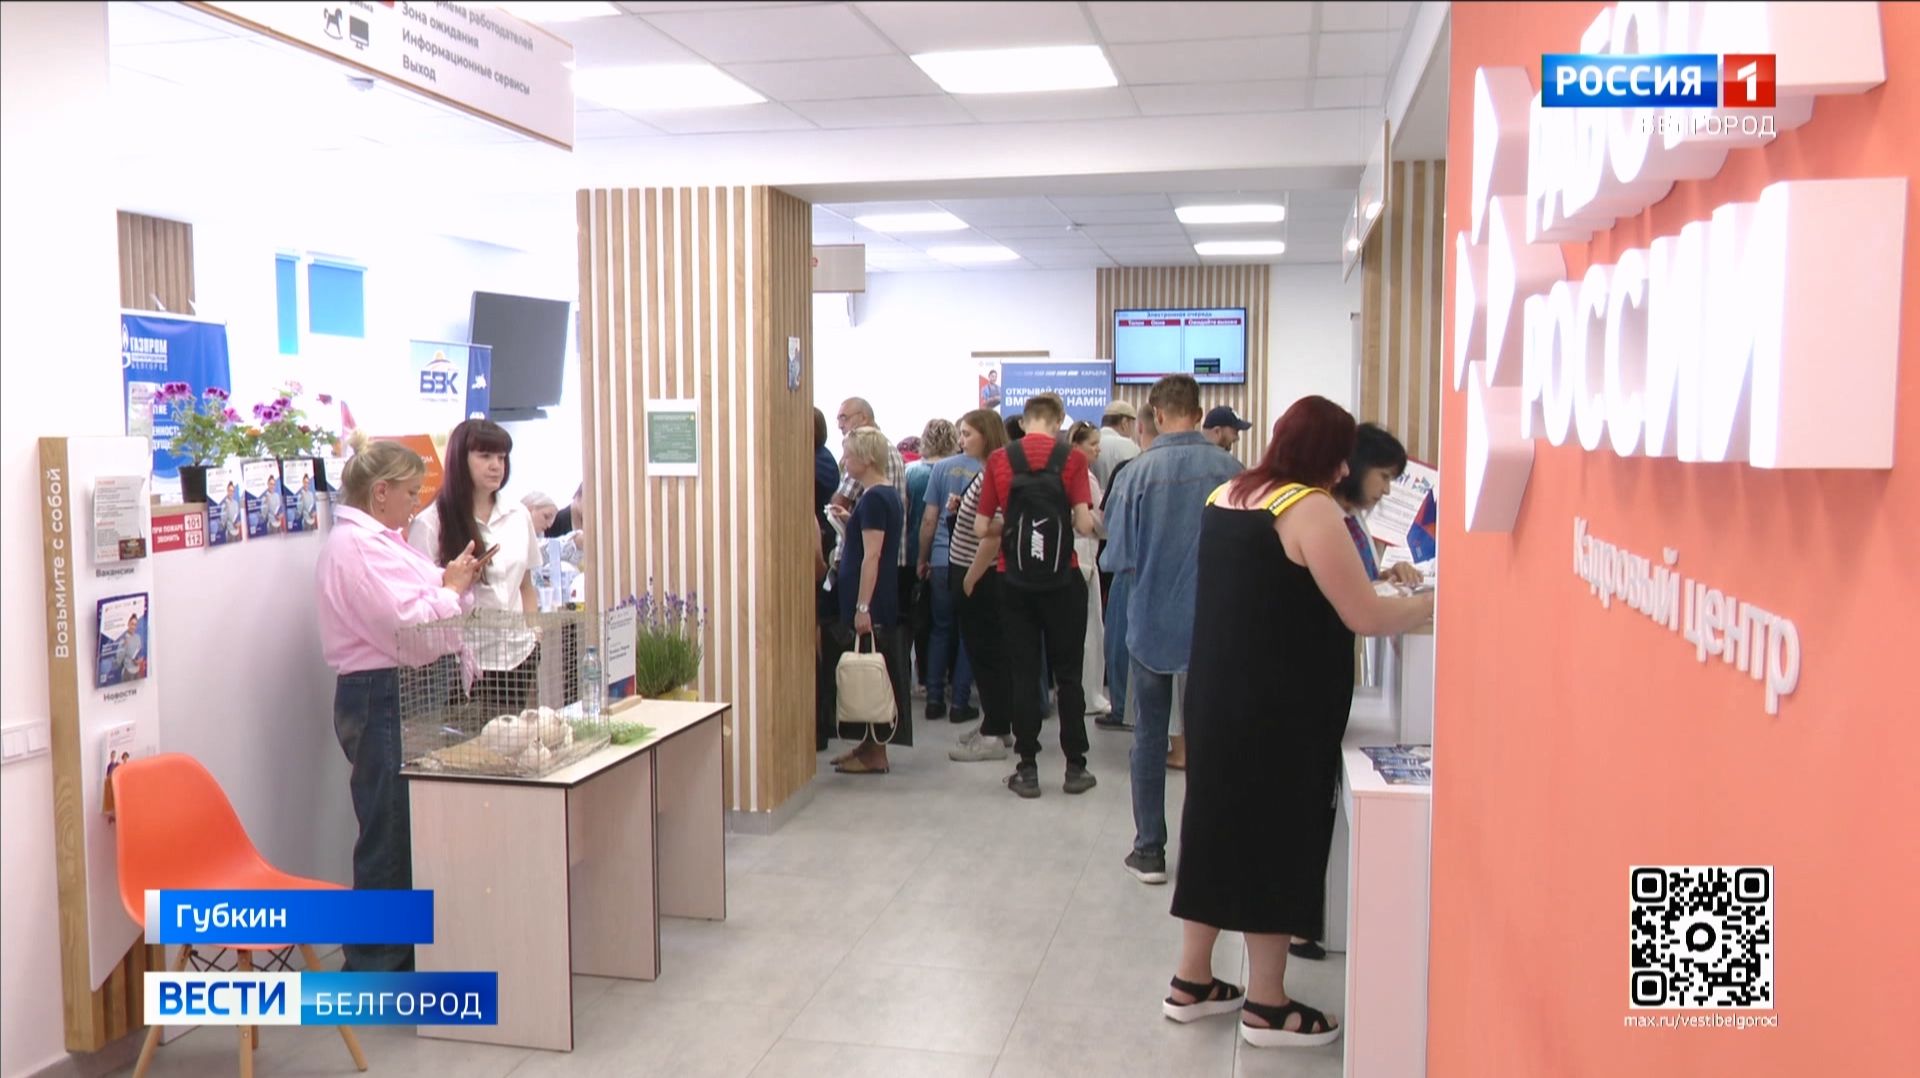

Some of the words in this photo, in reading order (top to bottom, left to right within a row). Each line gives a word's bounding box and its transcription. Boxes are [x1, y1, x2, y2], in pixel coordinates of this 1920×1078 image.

[402, 2, 428, 26] Зона
[430, 18, 480, 49] ожидания
[469, 8, 534, 51] работодателей
[402, 28, 492, 80] Информационные
[494, 71, 530, 95] сервисы
[402, 55, 436, 82] Выход
[1521, 180, 1790, 470] РОССИИ
[130, 336, 168, 353] ГАЗПРОМ
[1005, 386, 1052, 397] ОТКРЫВАЙ
[1053, 387, 1107, 396] ГОРИЗОНТЫ
[1066, 396, 1107, 407] НАМИ!
[48, 468, 63, 533] собой
[187, 518, 200, 530] 101
[53, 538, 64, 549] с
[188, 534, 201, 545] 112
[1031, 530, 1044, 561] NIKE
[95, 567, 135, 578] Вакансии
[55, 556, 69, 658] Возьмите
[1573, 516, 1680, 631] Кадровый
[1683, 578, 1801, 715] центр
[103, 688, 137, 702] Новости
